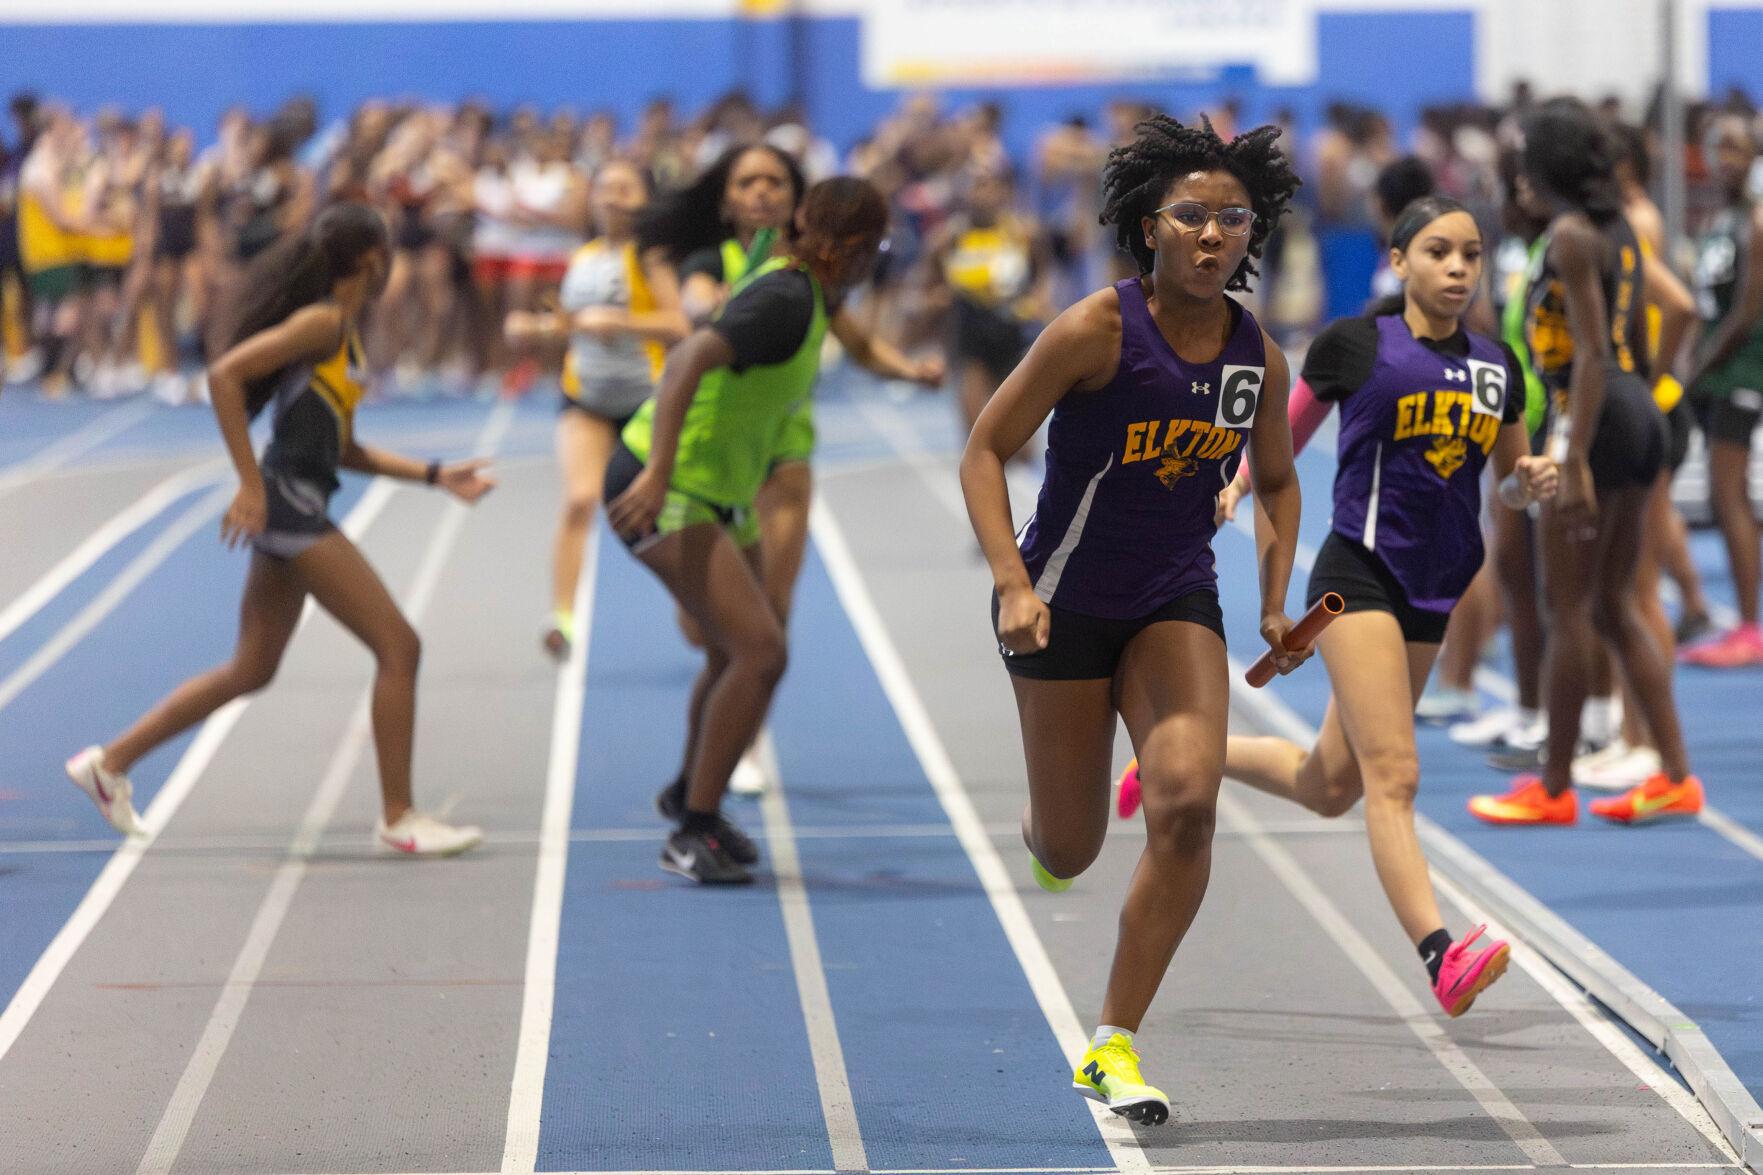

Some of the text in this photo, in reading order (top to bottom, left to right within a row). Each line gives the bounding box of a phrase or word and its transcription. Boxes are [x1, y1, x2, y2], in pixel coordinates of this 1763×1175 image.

[1221, 369, 1260, 425] 6
[1476, 367, 1503, 413] 6
[1122, 419, 1242, 464] ELKTON
